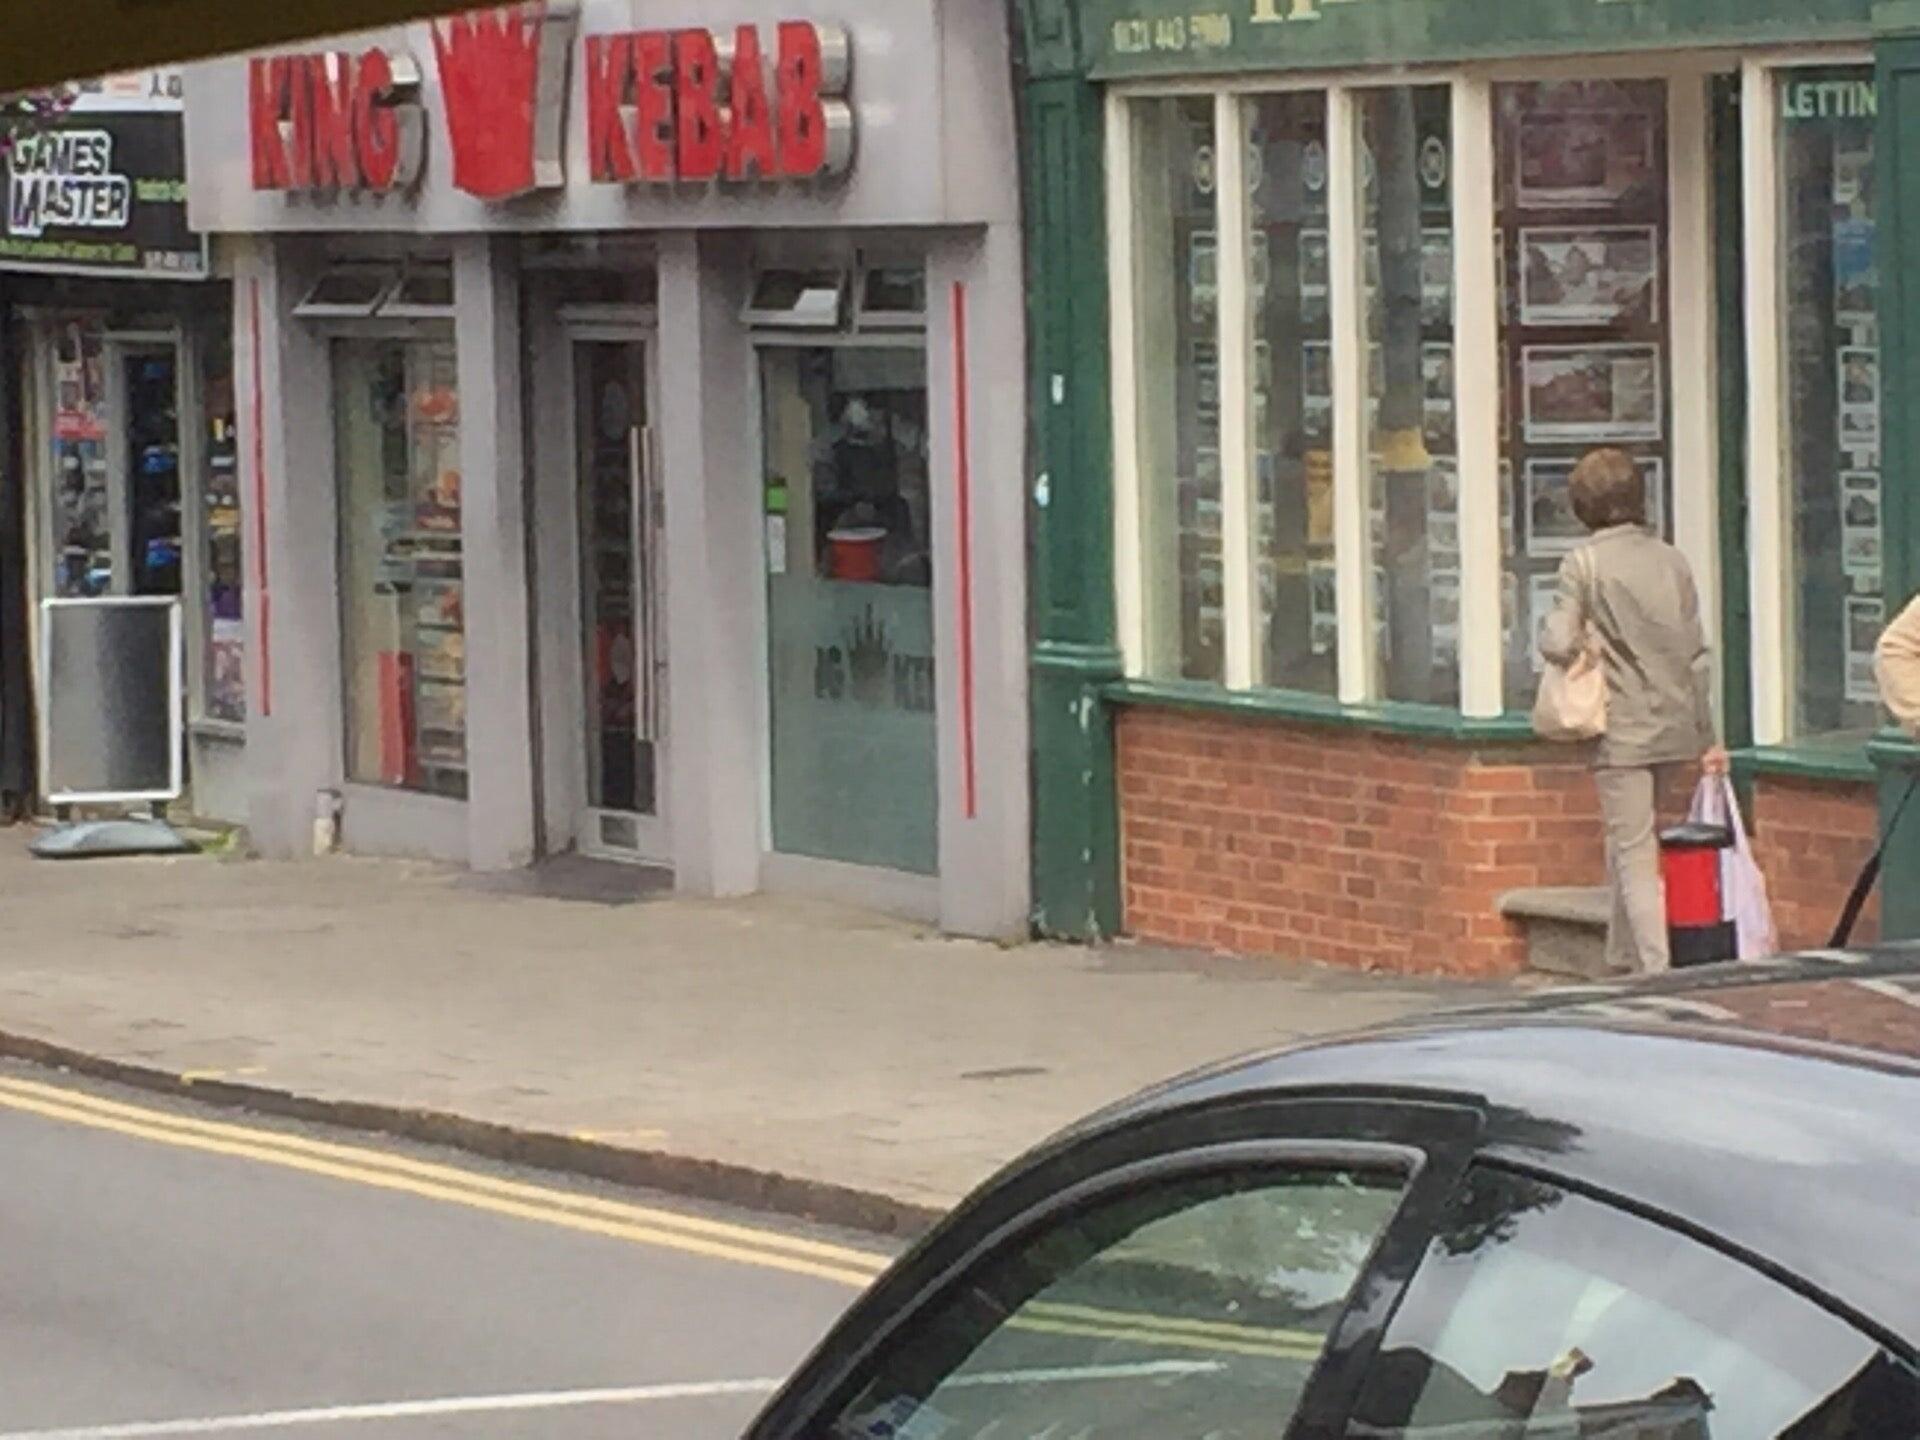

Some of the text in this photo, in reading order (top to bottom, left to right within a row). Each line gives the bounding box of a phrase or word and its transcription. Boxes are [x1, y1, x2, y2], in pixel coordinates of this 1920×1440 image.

[249, 21, 826, 189] KING KEBAB
[10, 174, 129, 234] MASTER
